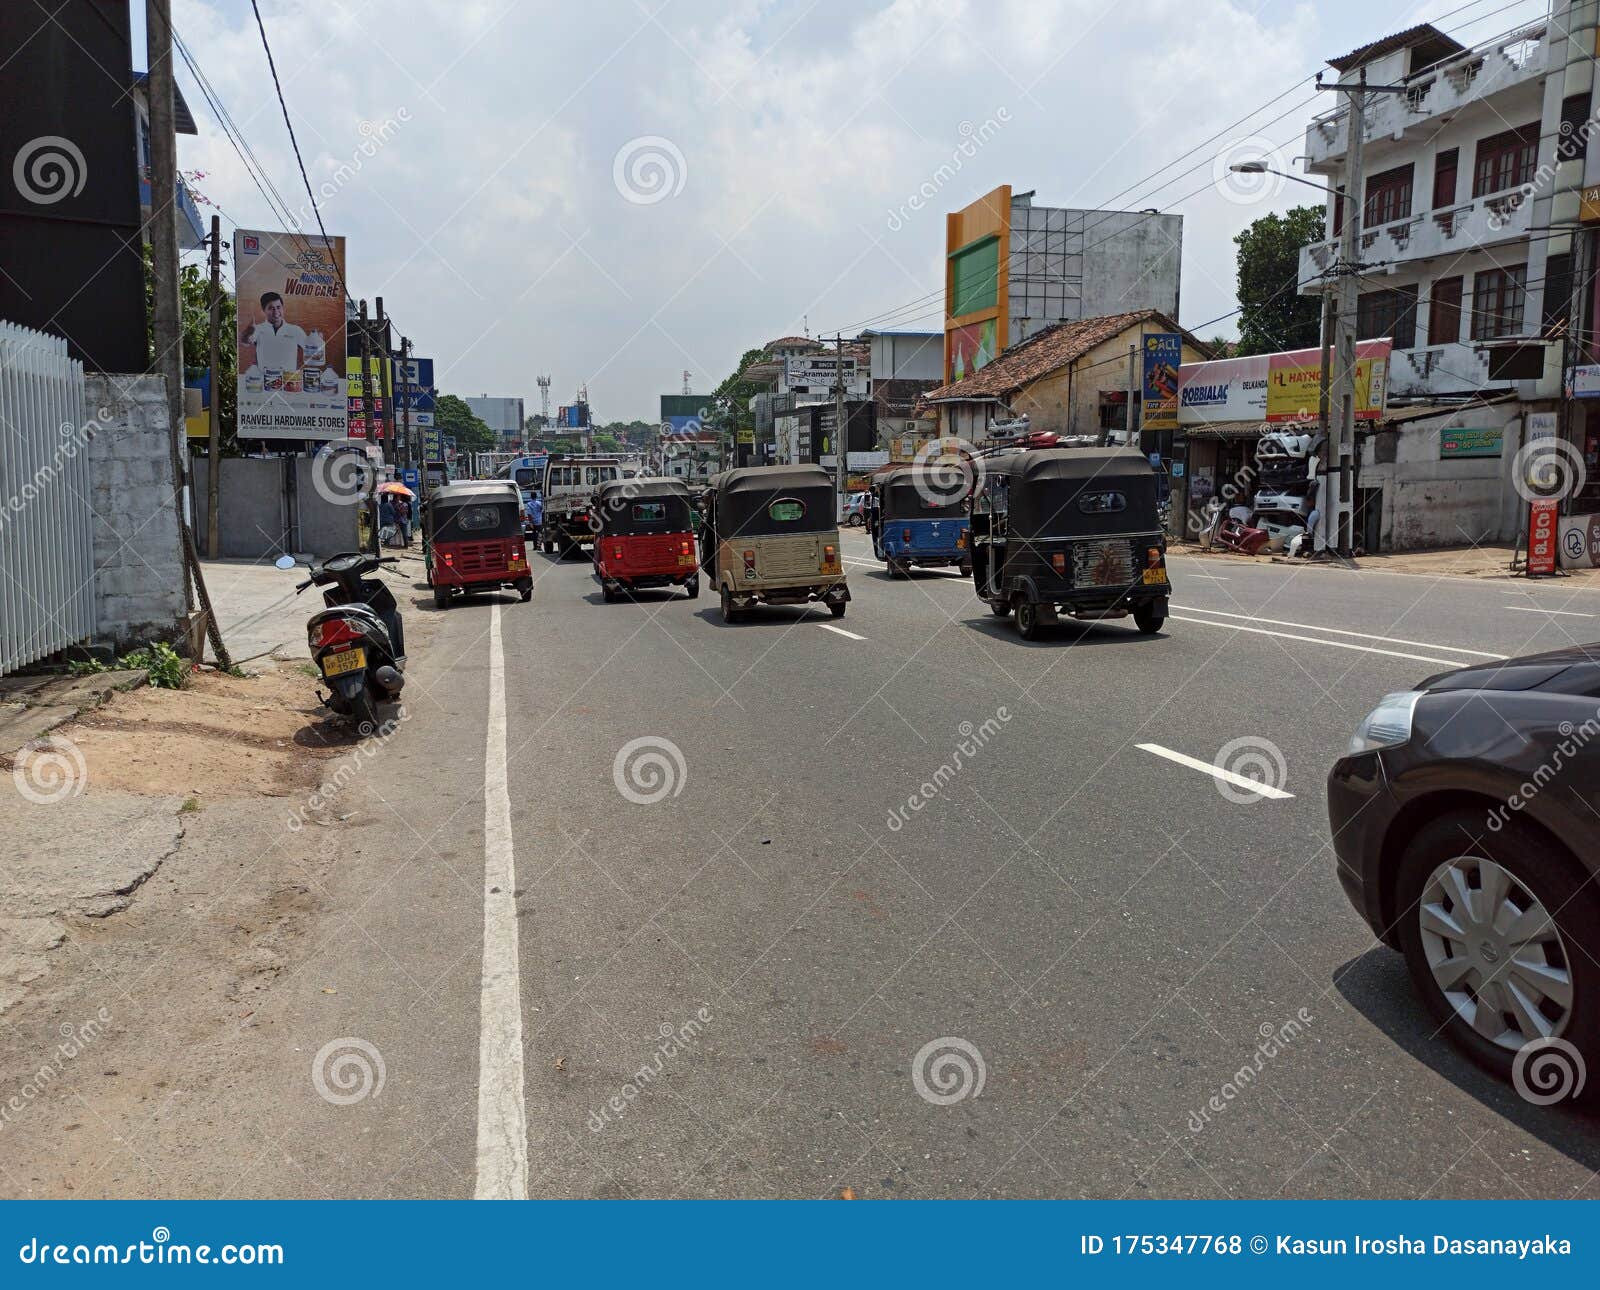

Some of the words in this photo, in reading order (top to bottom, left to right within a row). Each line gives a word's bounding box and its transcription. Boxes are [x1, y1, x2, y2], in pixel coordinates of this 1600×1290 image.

[240, 414, 273, 426] RANVELI
[274, 415, 316, 427] HARDWARE
[317, 416, 345, 428] STORES
